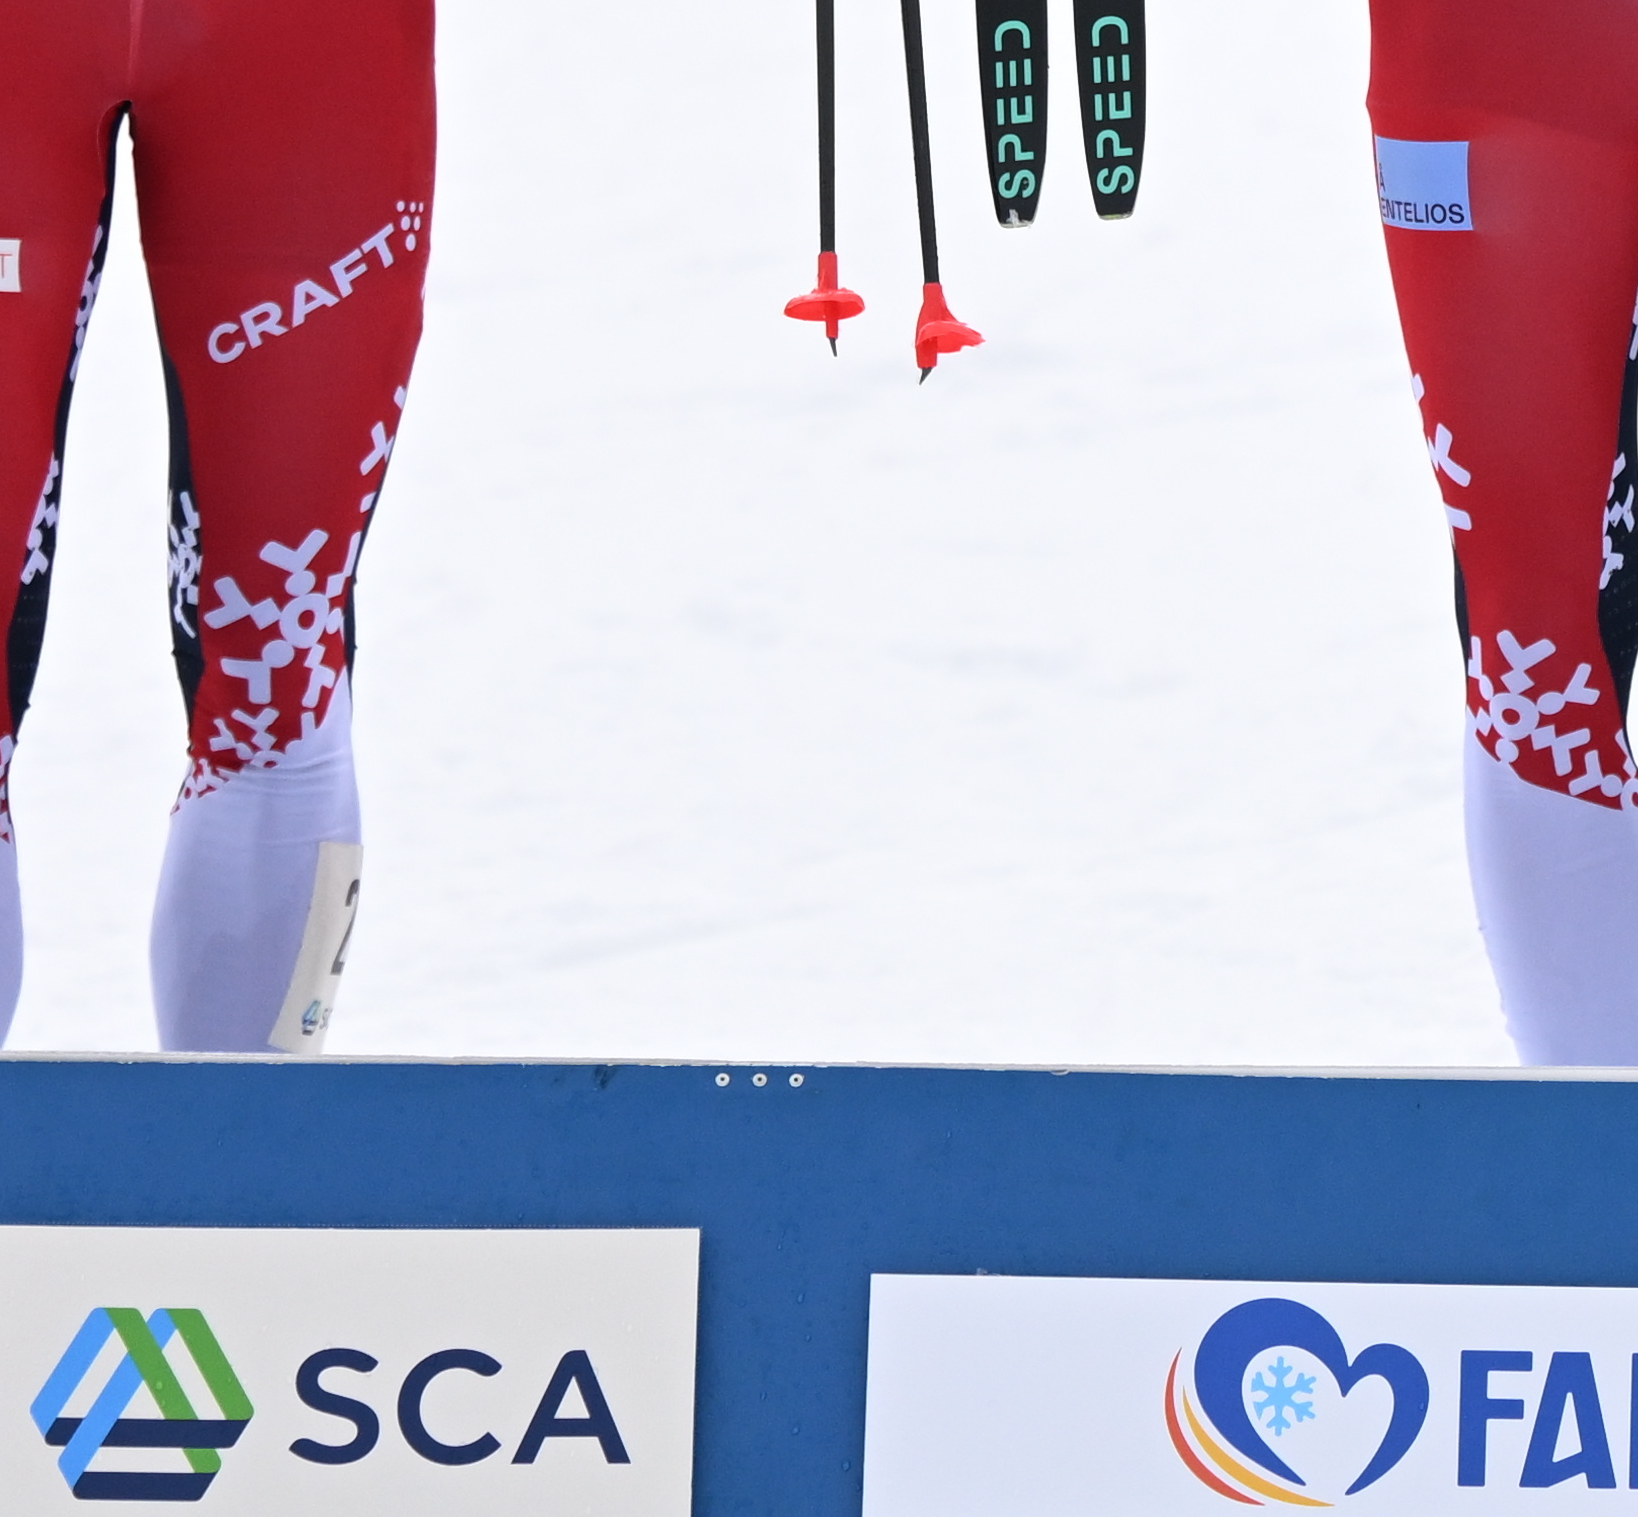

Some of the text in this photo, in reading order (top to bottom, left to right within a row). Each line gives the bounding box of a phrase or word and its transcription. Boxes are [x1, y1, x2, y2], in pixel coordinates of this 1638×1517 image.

[995, 21, 1035, 199] SPEED
[1092, 15, 1133, 193] SPEED
[1380, 198, 1465, 225] ENTELIOS
[207, 224, 397, 364] CRAFT
[288, 1347, 631, 1466] SCA
